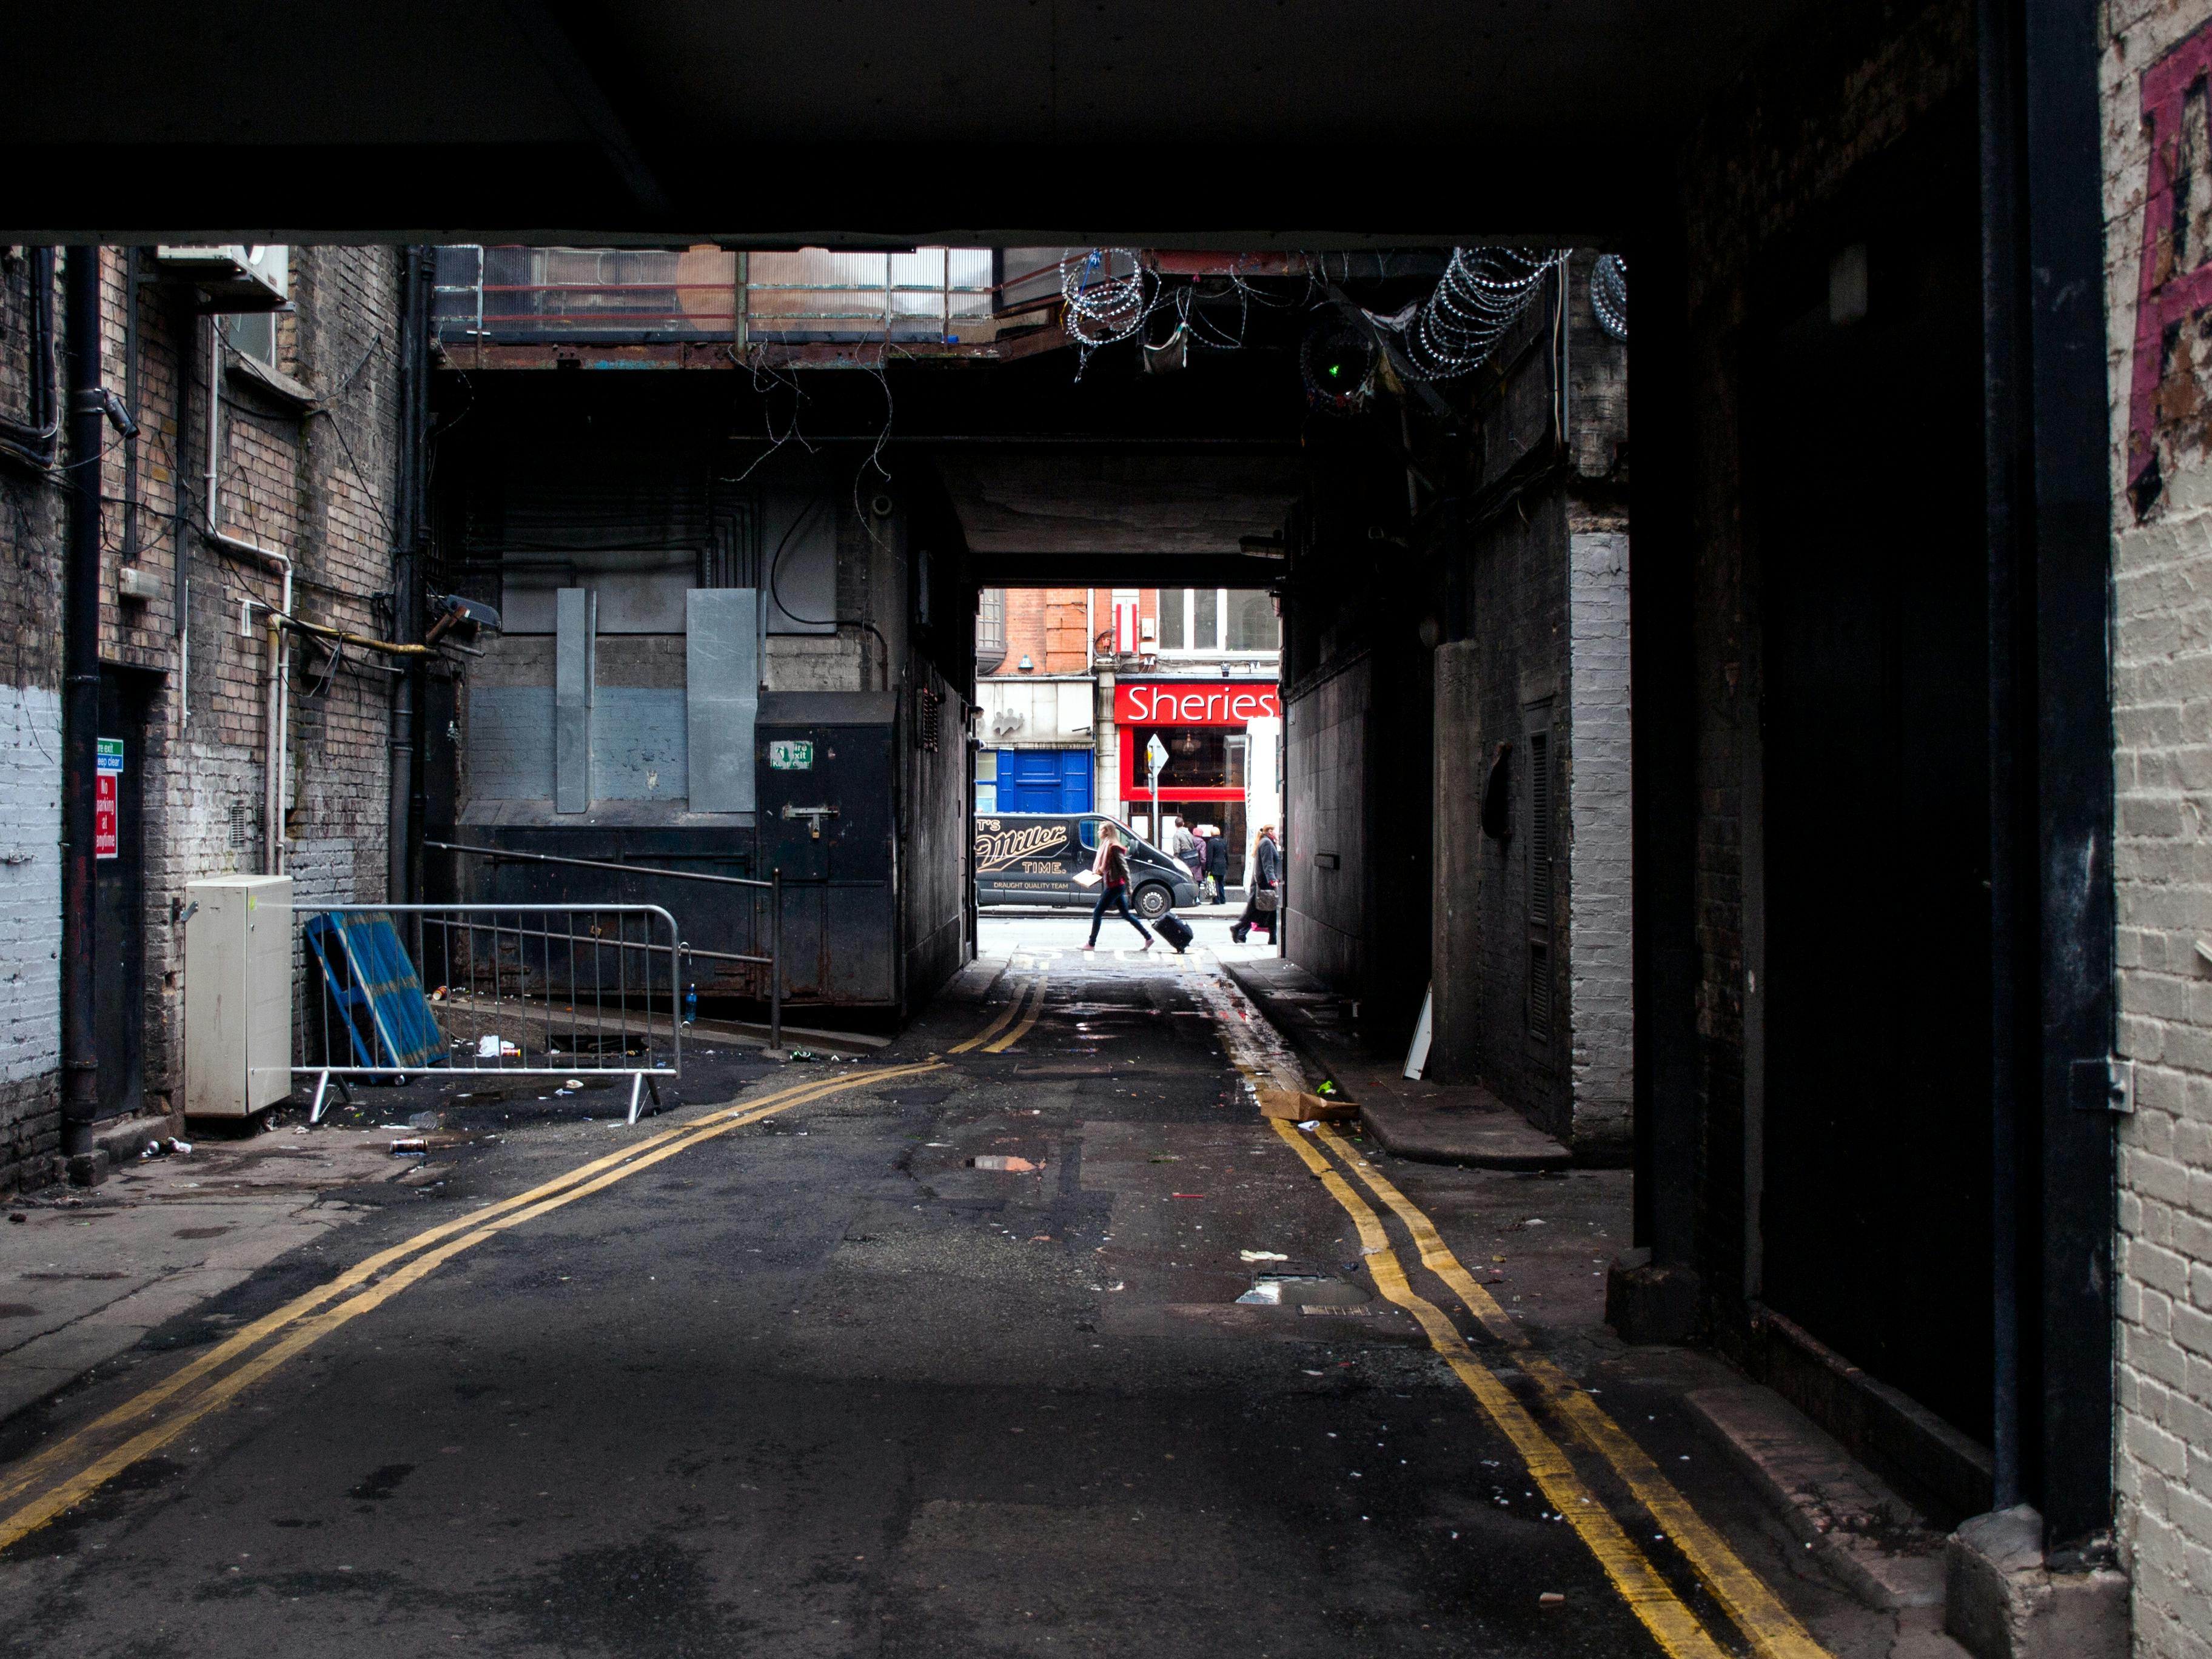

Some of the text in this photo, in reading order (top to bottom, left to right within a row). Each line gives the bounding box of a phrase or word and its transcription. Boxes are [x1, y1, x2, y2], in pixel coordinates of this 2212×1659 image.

[1128, 686, 1275, 720] Sheries
[104, 743, 113, 753] exit
[97, 756, 120, 768] eep clear
[101, 779, 108, 794] No
[97, 797, 114, 815] parking
[102, 814, 107, 830] at
[977, 819, 1001, 832] T'S
[97, 832, 115, 850] anytime
[977, 825, 1067, 872] Miller
[1022, 862, 1067, 874] TIME.
